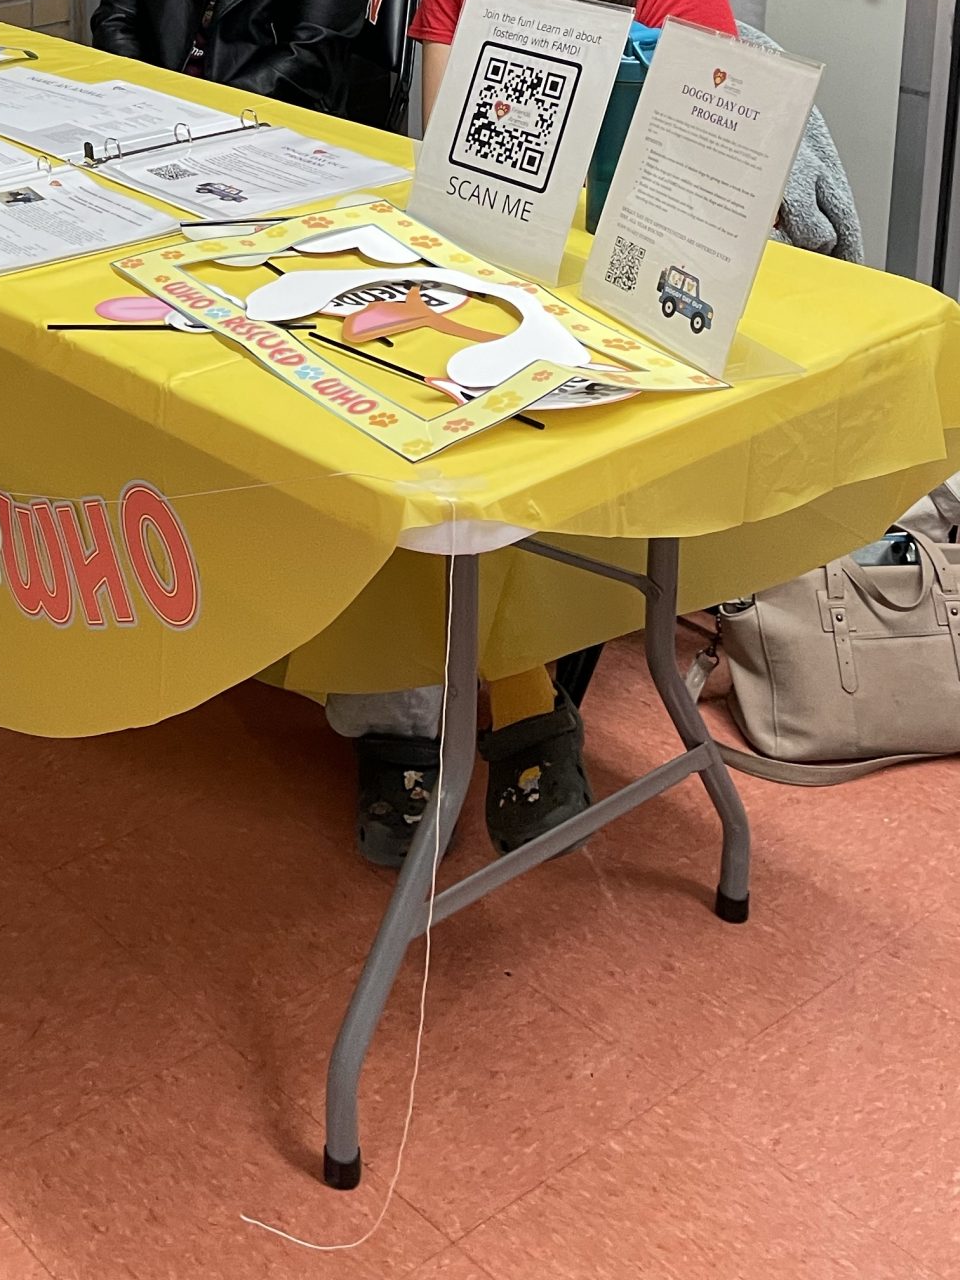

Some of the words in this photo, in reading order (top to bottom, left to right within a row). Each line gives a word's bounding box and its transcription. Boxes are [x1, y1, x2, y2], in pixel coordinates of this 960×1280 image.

[483, 9, 500, 21] Join
[502, 13, 516, 25] the
[518, 16, 535, 28] fun!
[537, 21, 561, 35] Learn
[563, 28, 575, 38] all
[576, 31, 602, 45] about
[493, 26, 529, 45] fostering
[531, 38, 549, 49] with
[551, 40, 582, 56] FAMD!
[681, 84, 716, 104] DOGGY
[716, 97, 738, 112] DAY
[737, 105, 761, 121] OUT
[691, 105, 738, 132] PROGRAM
[446, 176, 498, 210] SCAN
[502, 194, 534, 222] ME
[162, 281, 215, 310] WHO
[219, 315, 306, 367] RESCUED
[311, 377, 380, 416] WHO
